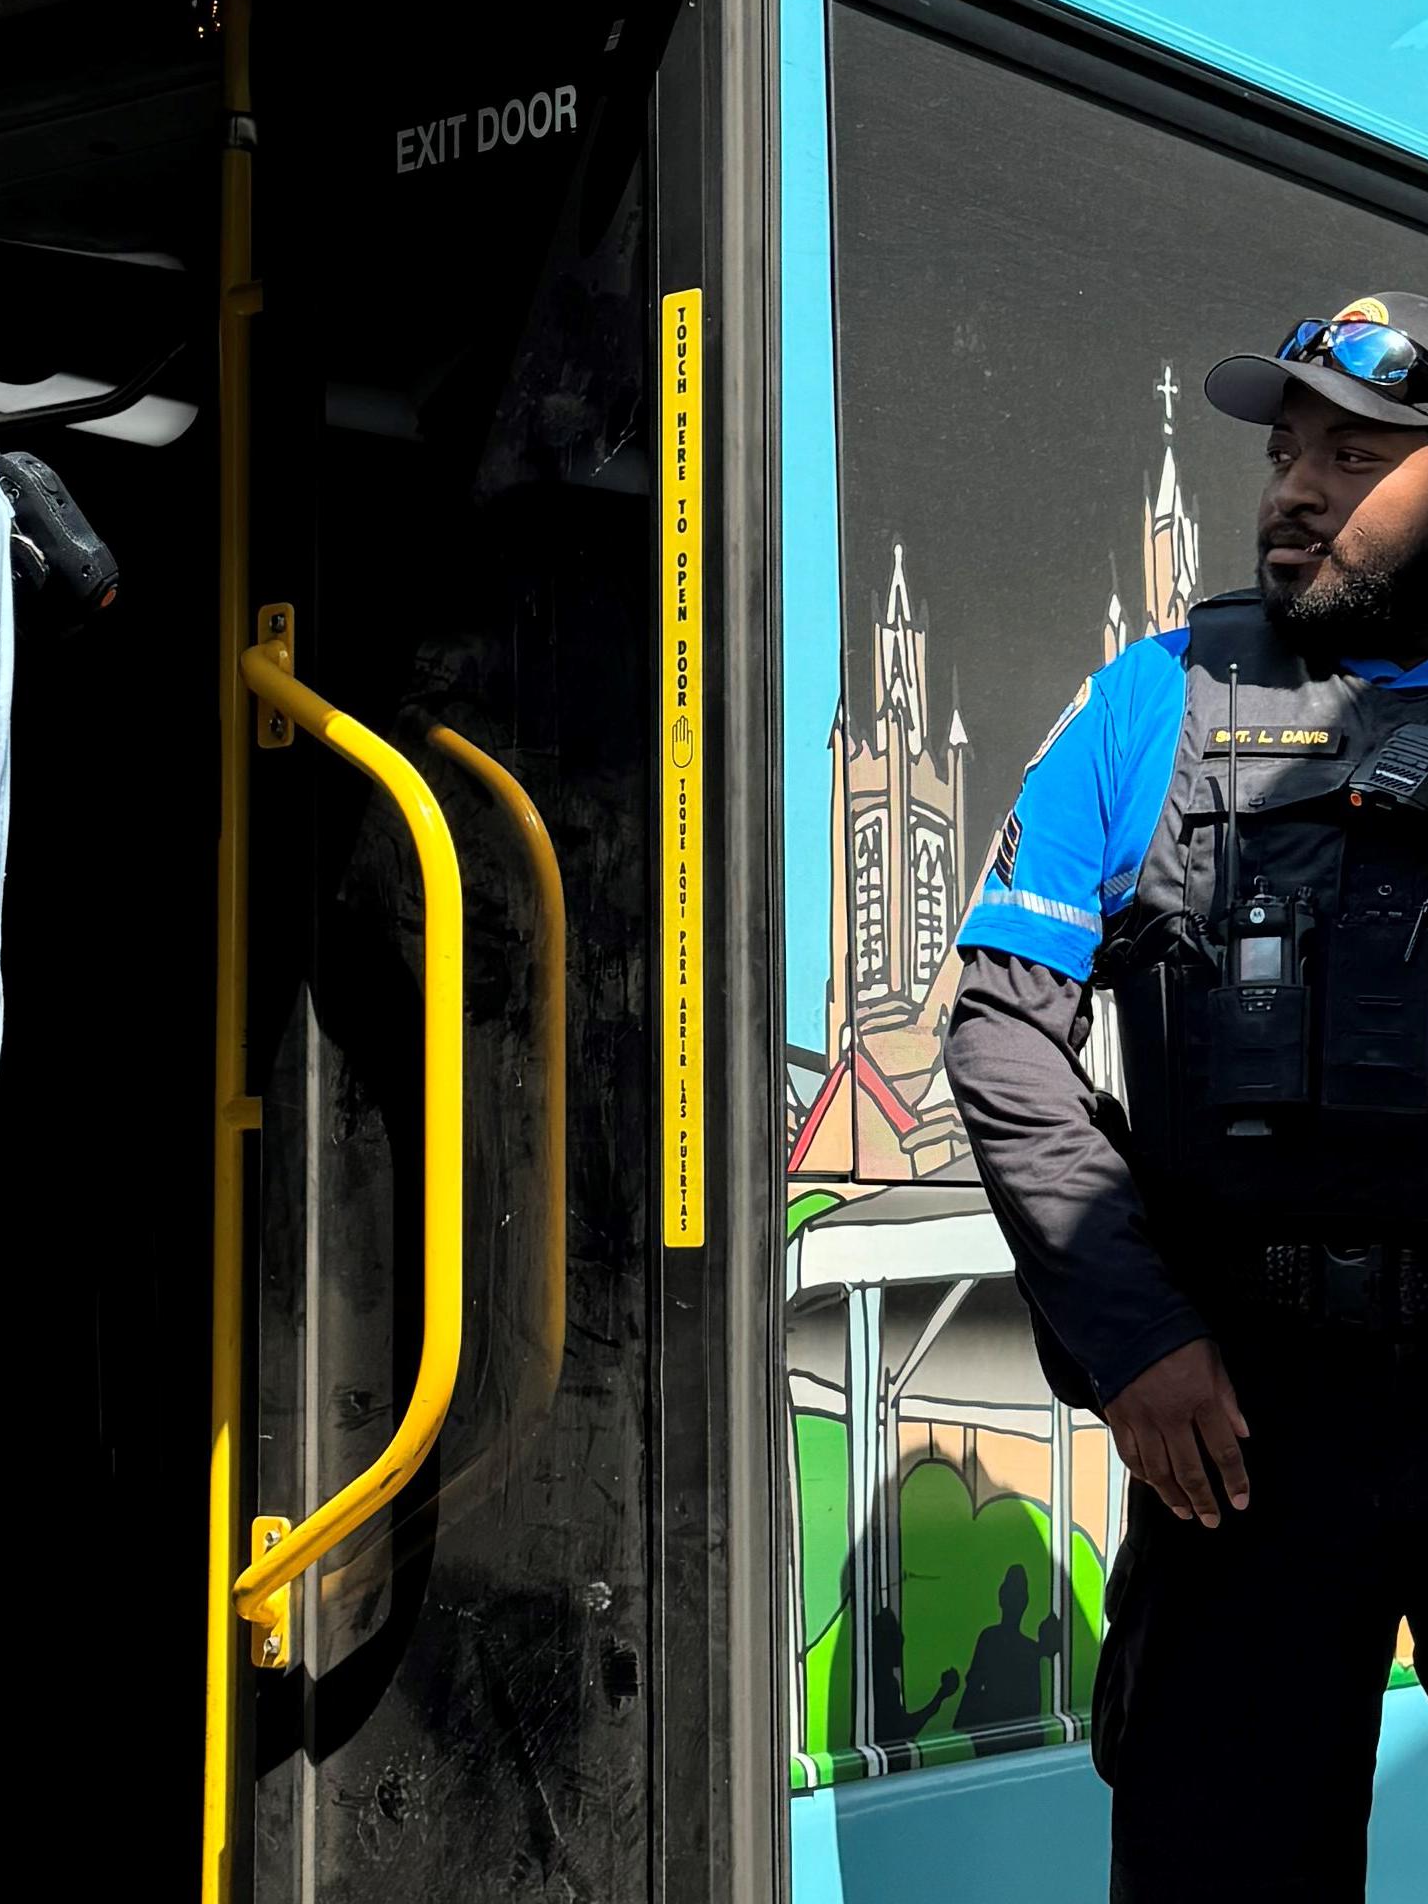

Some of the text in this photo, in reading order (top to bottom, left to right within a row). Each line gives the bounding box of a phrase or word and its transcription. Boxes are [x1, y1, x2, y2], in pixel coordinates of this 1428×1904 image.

[397, 84, 577, 174] EXIT DOOR
[677, 307, 687, 707] TOUCH HERE TO OPEN DOOR
[1215, 730, 1252, 744] ST.
[1280, 730, 1329, 744] DAVIS
[679, 778, 688, 1232] TOQUE AQUI PARA ABRIR LAS PUERTAS
